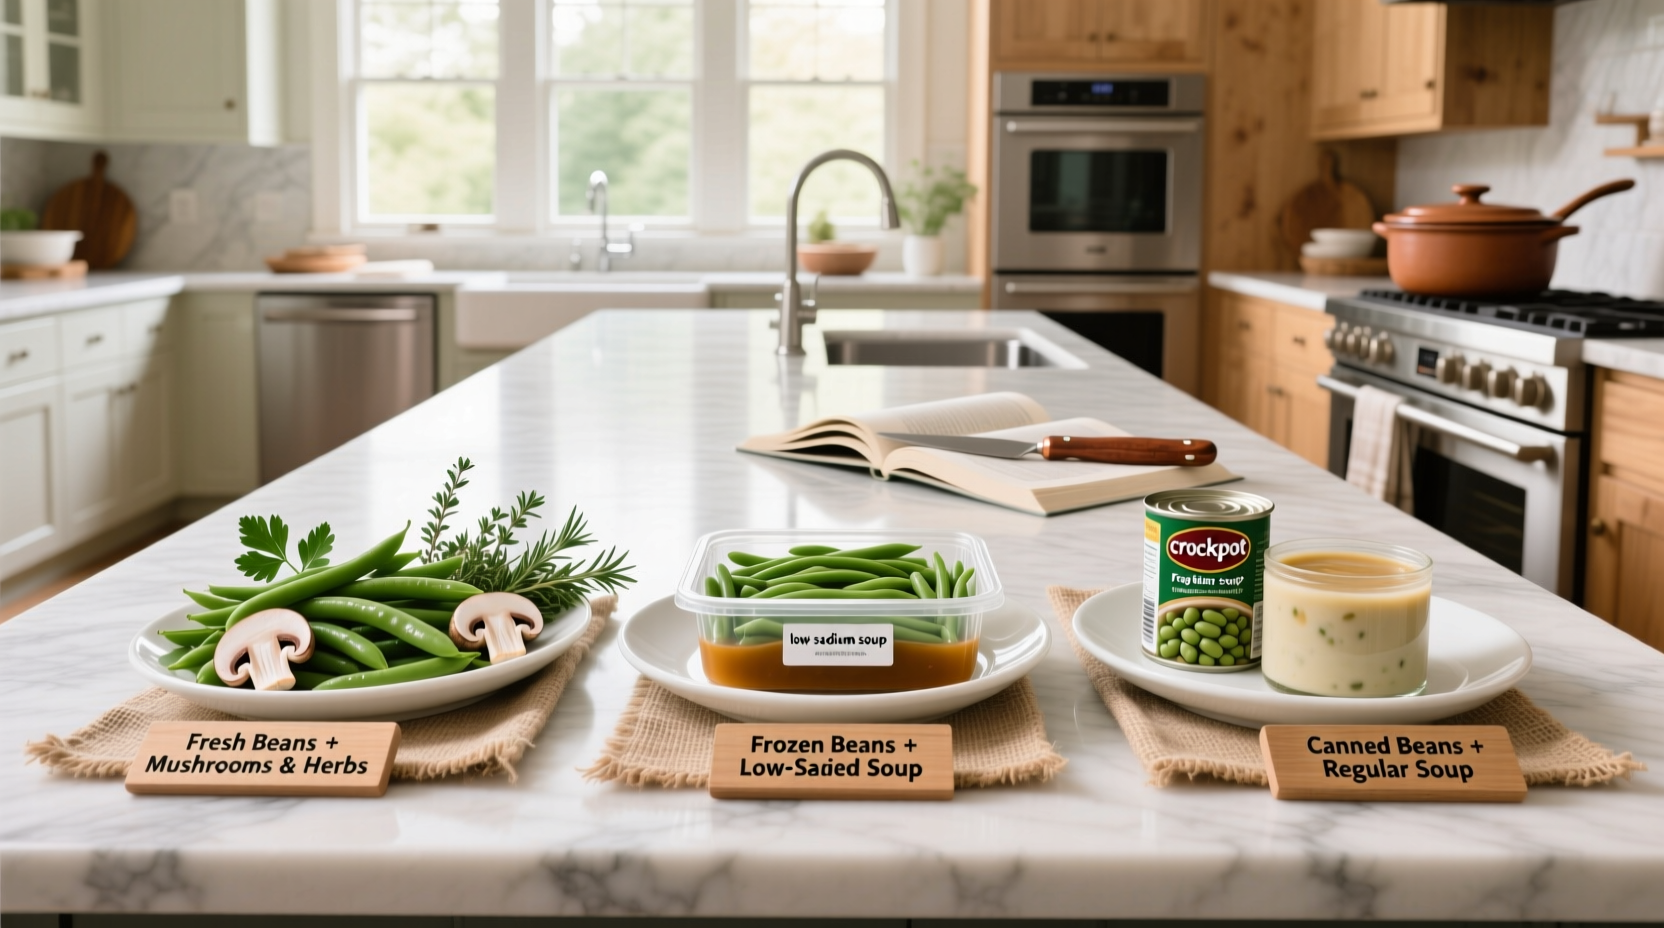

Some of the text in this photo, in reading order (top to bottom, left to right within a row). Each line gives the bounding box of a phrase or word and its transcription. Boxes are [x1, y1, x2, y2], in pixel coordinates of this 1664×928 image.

[1170, 537, 1247, 562] crockpot
[790, 632, 811, 646] low
[858, 636, 887, 649] soup
[186, 733, 339, 751] Fresh Beans +
[751, 735, 917, 754] Frozen Beans +
[1306, 735, 1484, 755] Canned Beans +
[145, 755, 368, 775] Mushrooms & Herbs
[867, 758, 923, 783] Soup
[1322, 758, 1474, 784] Regular Soup
